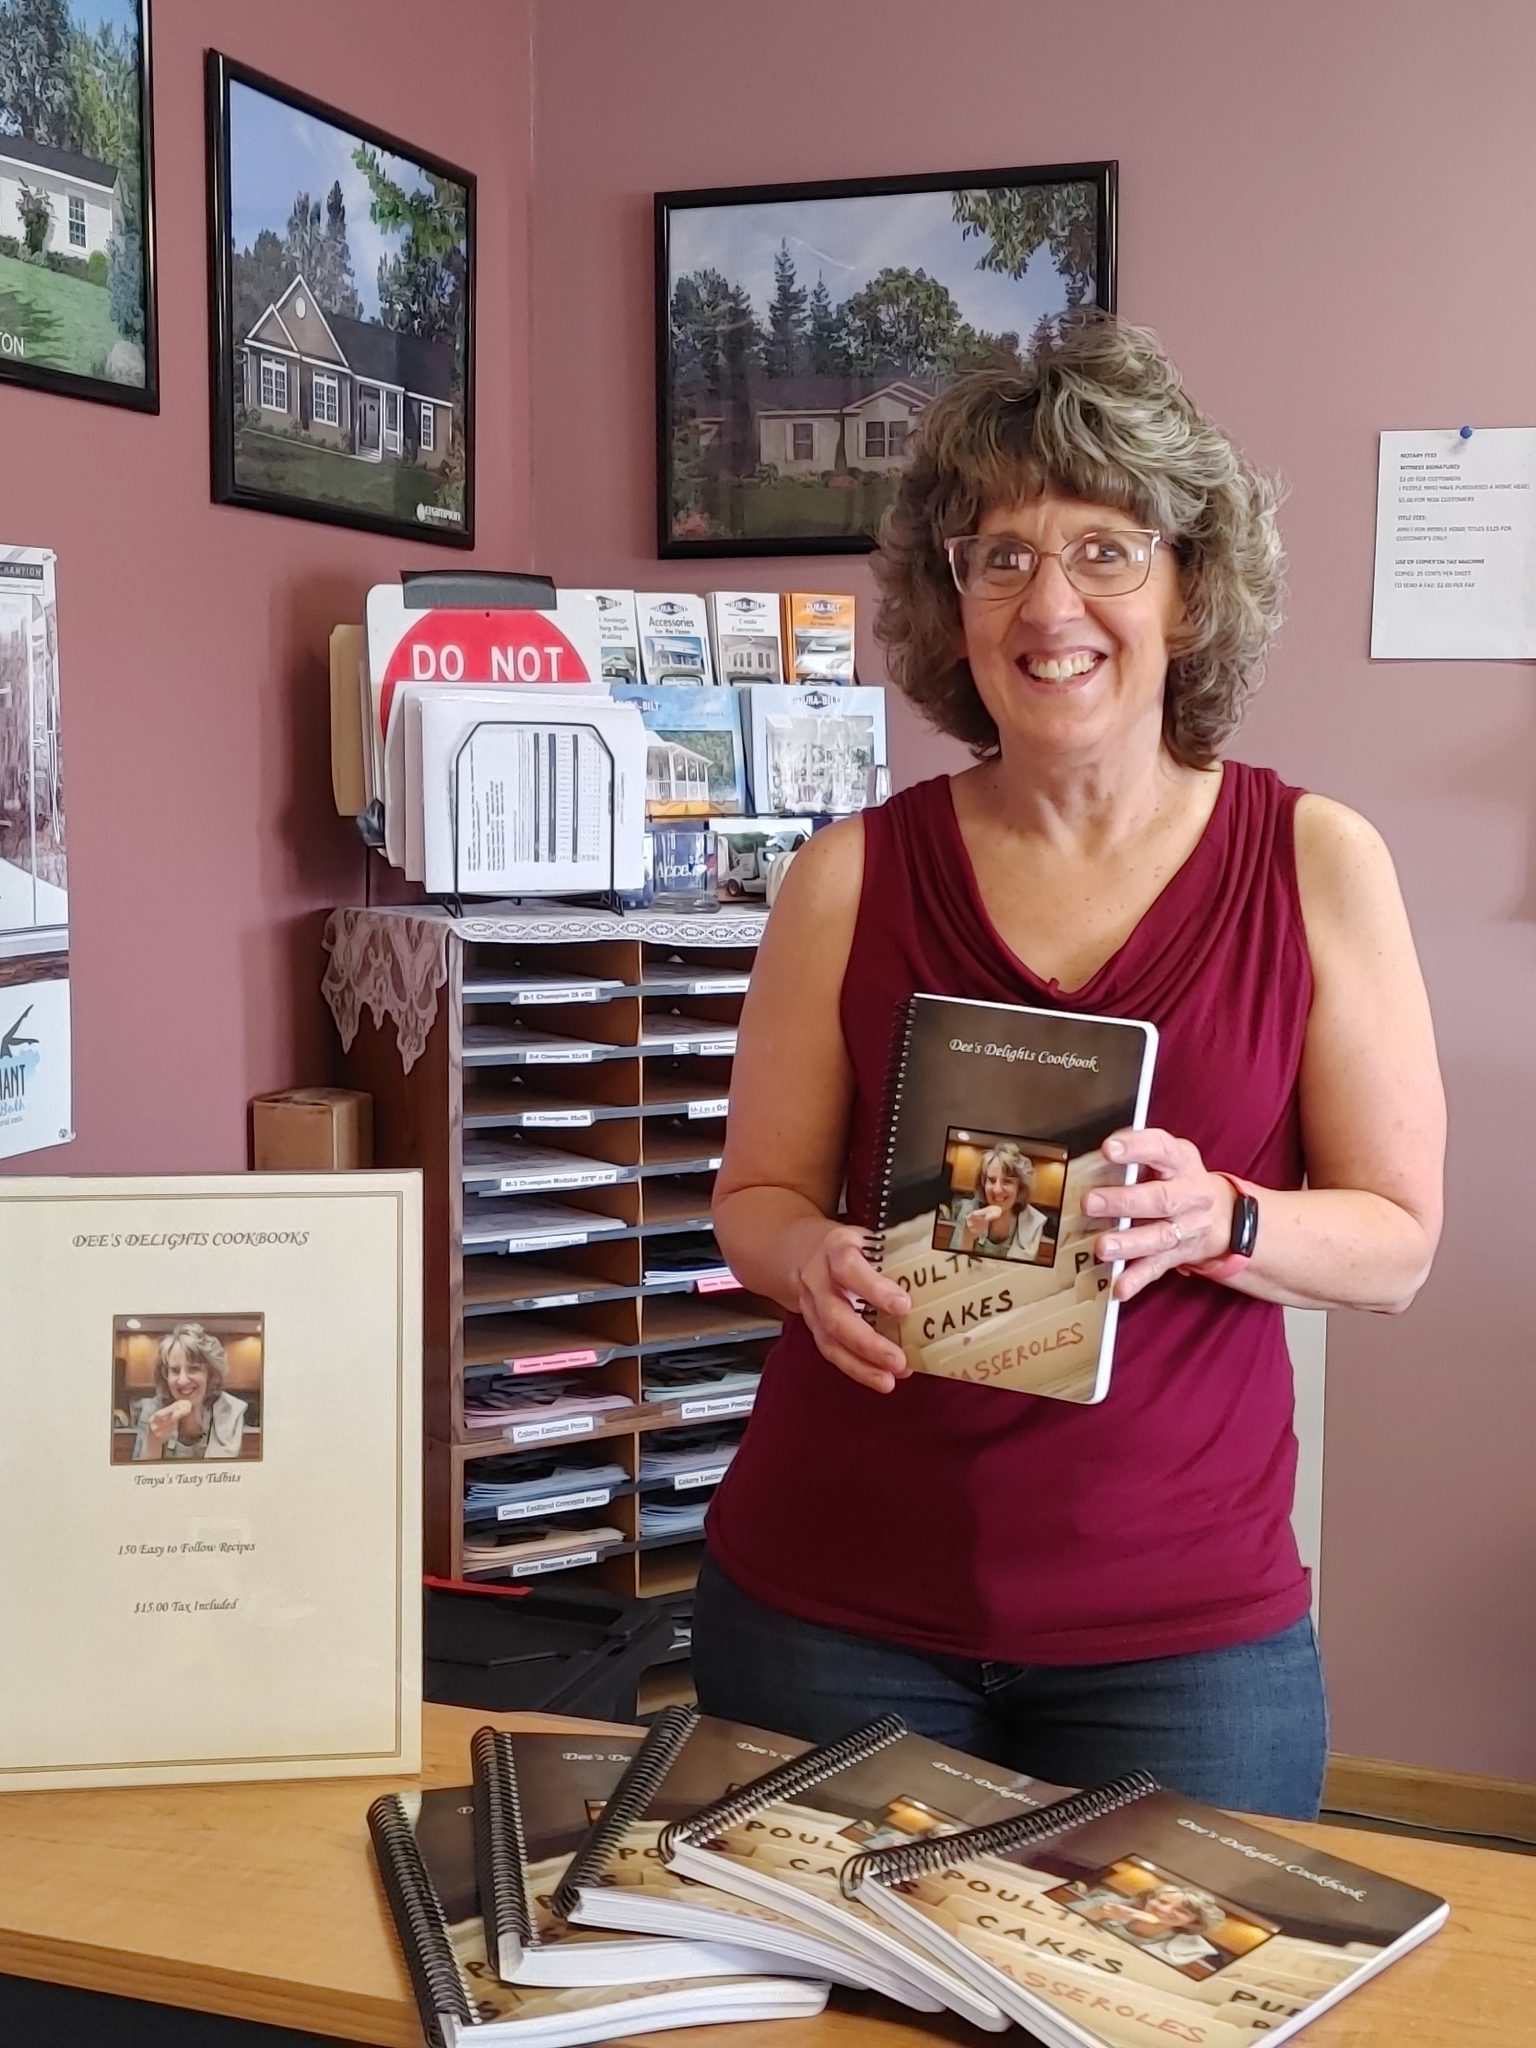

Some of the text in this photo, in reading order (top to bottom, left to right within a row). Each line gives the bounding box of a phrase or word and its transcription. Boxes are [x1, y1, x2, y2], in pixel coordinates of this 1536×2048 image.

[649, 616, 694, 628] Accessories
[412, 644, 564, 683] DO NOT
[949, 1038, 1100, 1073] Dee's Delights Cookbook
[0, 1064, 25, 1100] ANT
[72, 1231, 310, 1250] DEE'S DELIGHTS COOKBOOKS
[897, 1254, 983, 1293] OULT
[923, 1289, 1014, 1340] CAKES
[950, 1322, 1084, 1381] ASSEROLES
[135, 1471, 241, 1488] Tonya's Tasty Tidbits
[118, 1541, 256, 1557] 150 Easy to Follow Recipes
[134, 1598, 239, 1614] $15.00 Tax Included
[744, 1820, 848, 1854] POUL
[789, 1858, 838, 1878] CA
[1176, 1818, 1368, 1903] Dee's Delights Cookbook
[941, 1869, 1104, 1932] POULT
[976, 1914, 1124, 1975] CAKES
